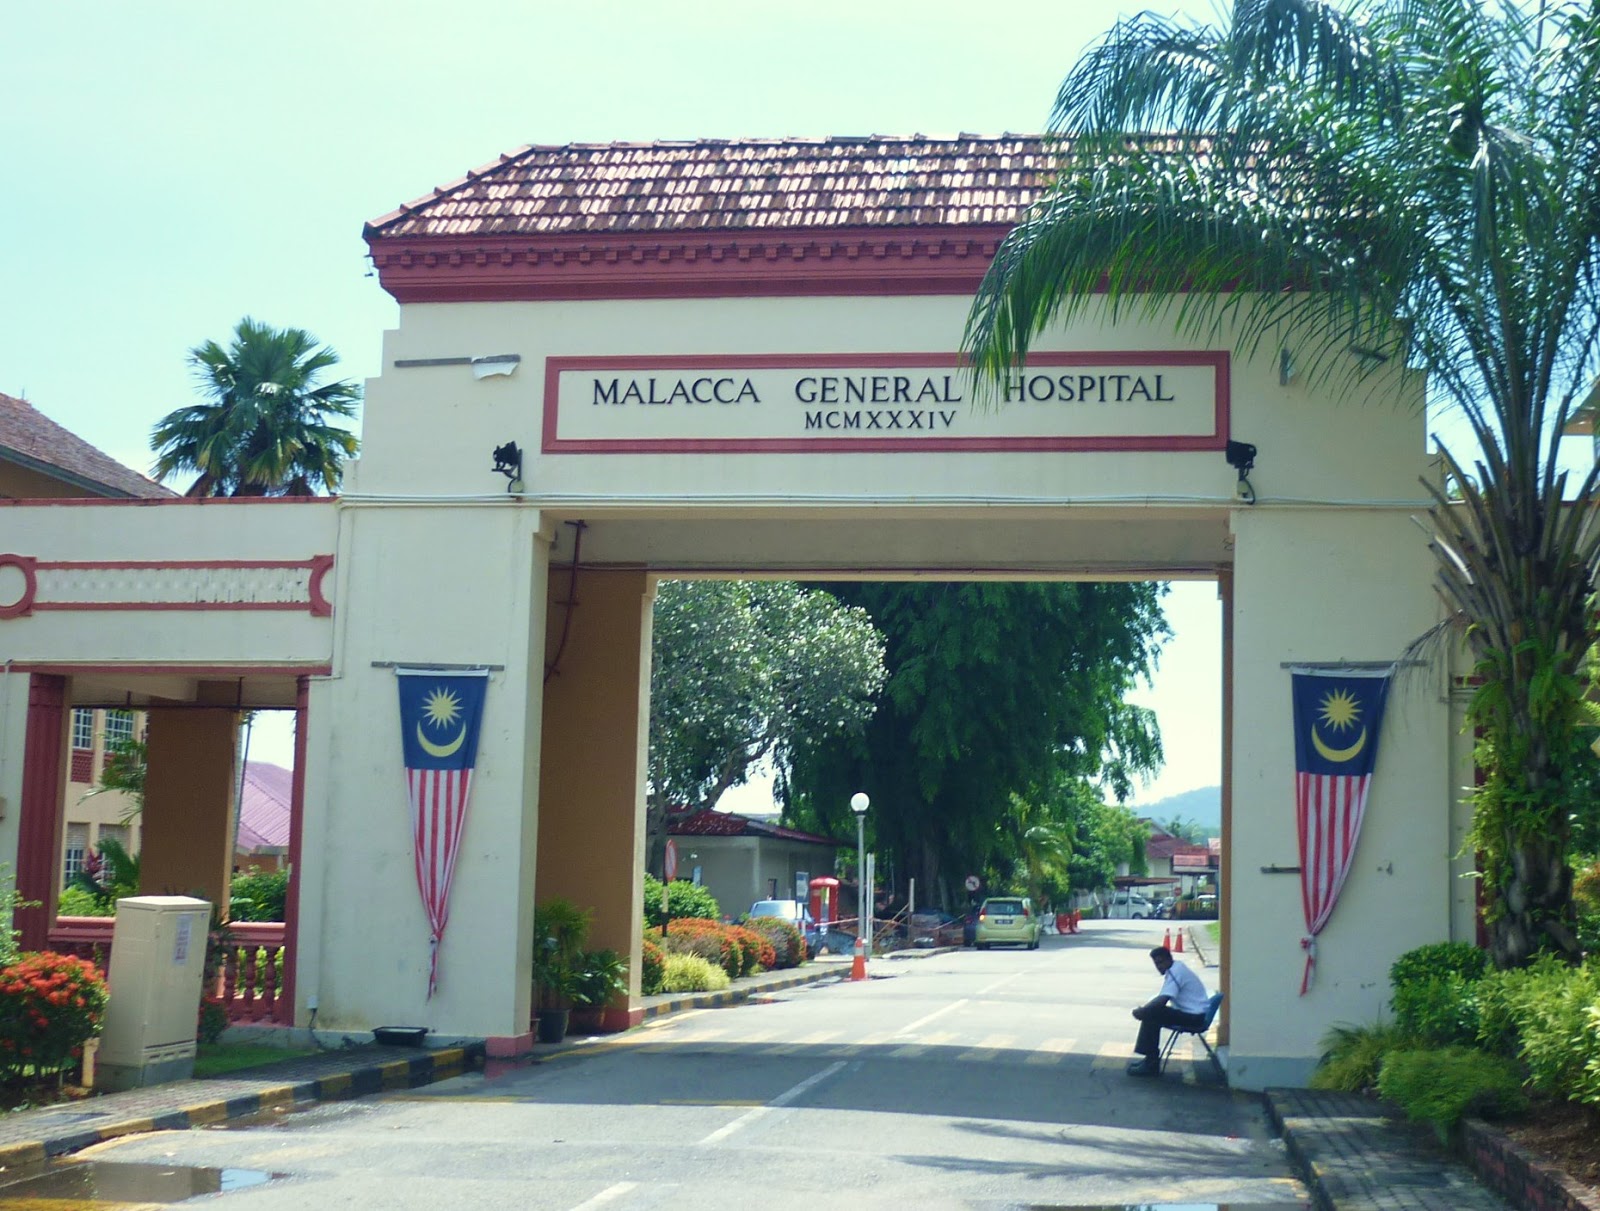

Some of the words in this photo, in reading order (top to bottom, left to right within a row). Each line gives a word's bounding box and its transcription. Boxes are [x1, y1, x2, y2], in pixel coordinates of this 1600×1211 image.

[593, 378, 760, 405] MALACCA
[794, 375, 962, 403] GENERAL
[1003, 375, 1174, 402] HOSPITAL
[805, 410, 957, 430] MCMXXXIV
